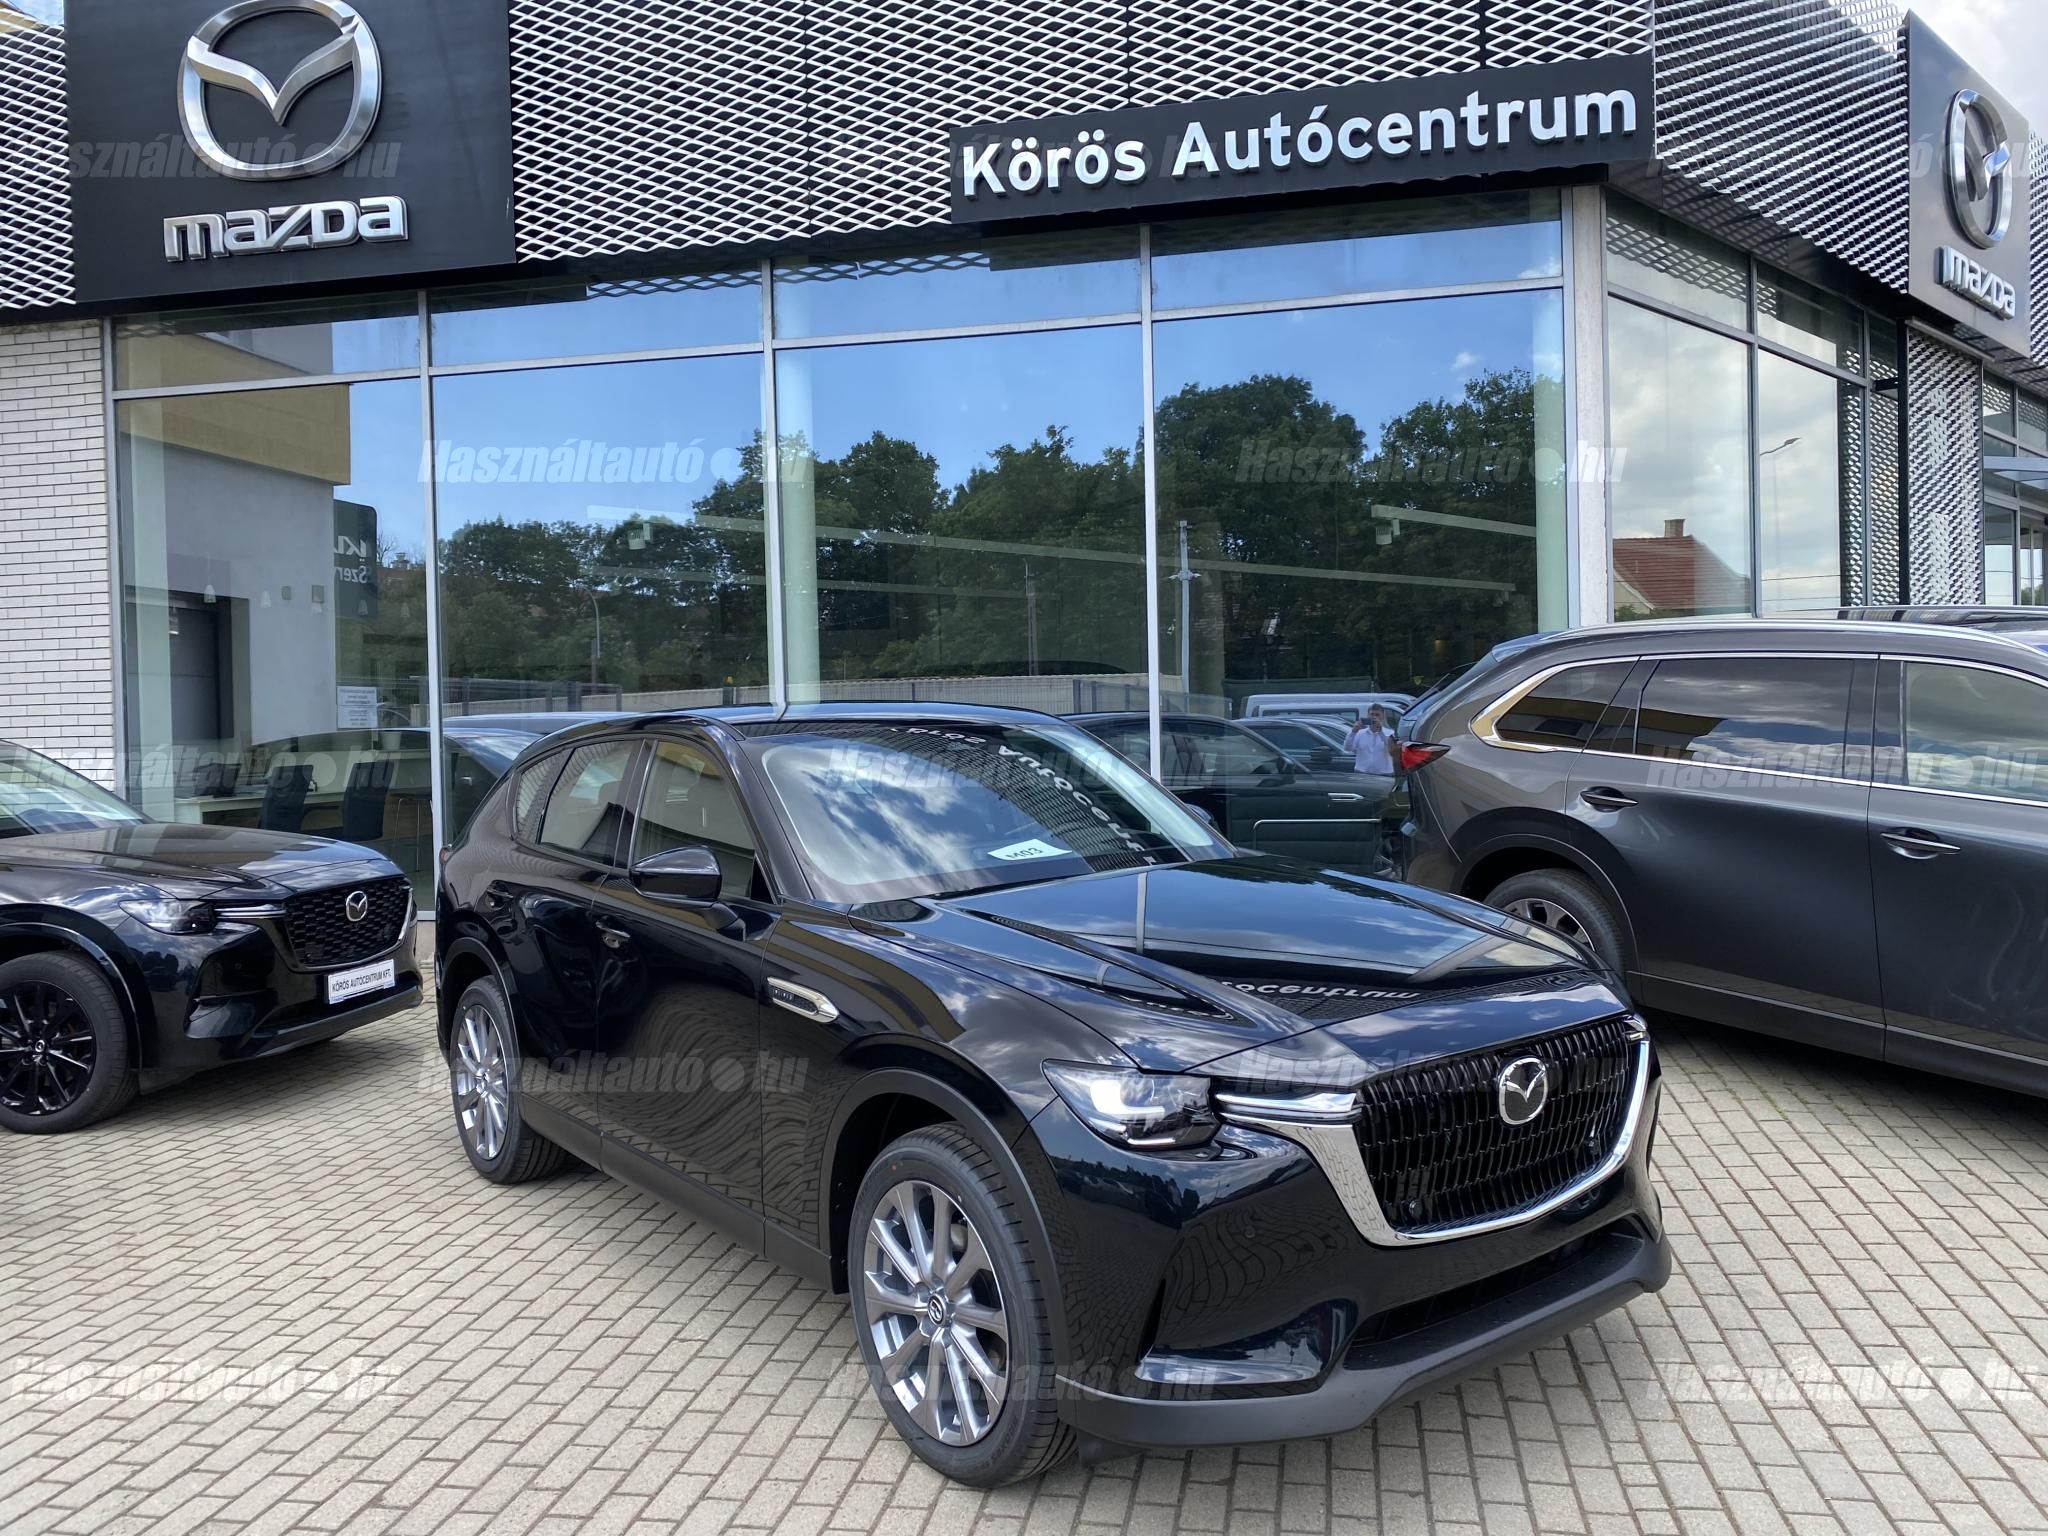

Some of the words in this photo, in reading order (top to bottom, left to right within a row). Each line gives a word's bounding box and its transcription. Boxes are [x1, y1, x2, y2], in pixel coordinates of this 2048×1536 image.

[963, 128, 1148, 197] Körös
[1171, 88, 1638, 178] Autócentrum
[163, 196, 409, 263] mazda
[1936, 245, 2016, 320] mazda
